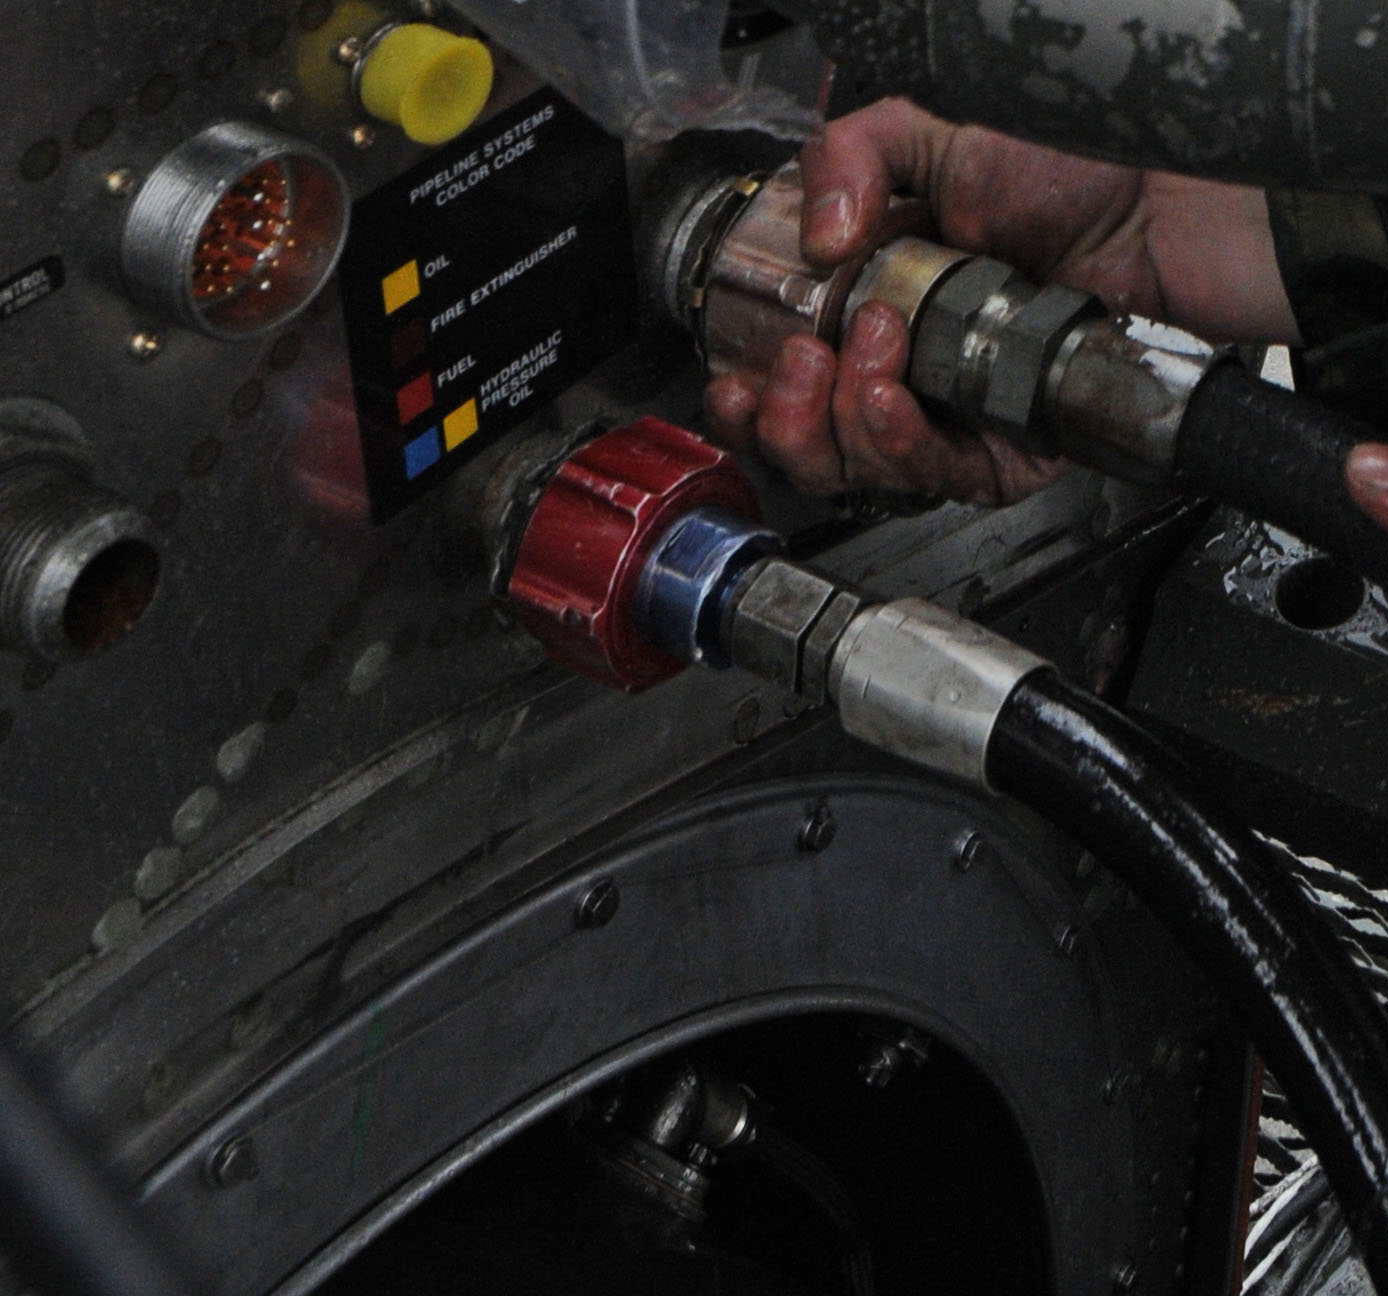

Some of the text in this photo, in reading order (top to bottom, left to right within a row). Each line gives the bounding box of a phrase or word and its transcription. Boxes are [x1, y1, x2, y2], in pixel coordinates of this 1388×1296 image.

[409, 105, 555, 205] PIPELINE SYSTEMS
[435, 134, 536, 206] COLOR CODE
[423, 254, 450, 279] OIL
[430, 225, 578, 333] FIRE EXTINGUISHER
[437, 354, 477, 388] FUEL
[480, 329, 562, 397] HYDRAULIC
[481, 349, 559, 413] PRESSURE
[509, 385, 534, 407] OIL
